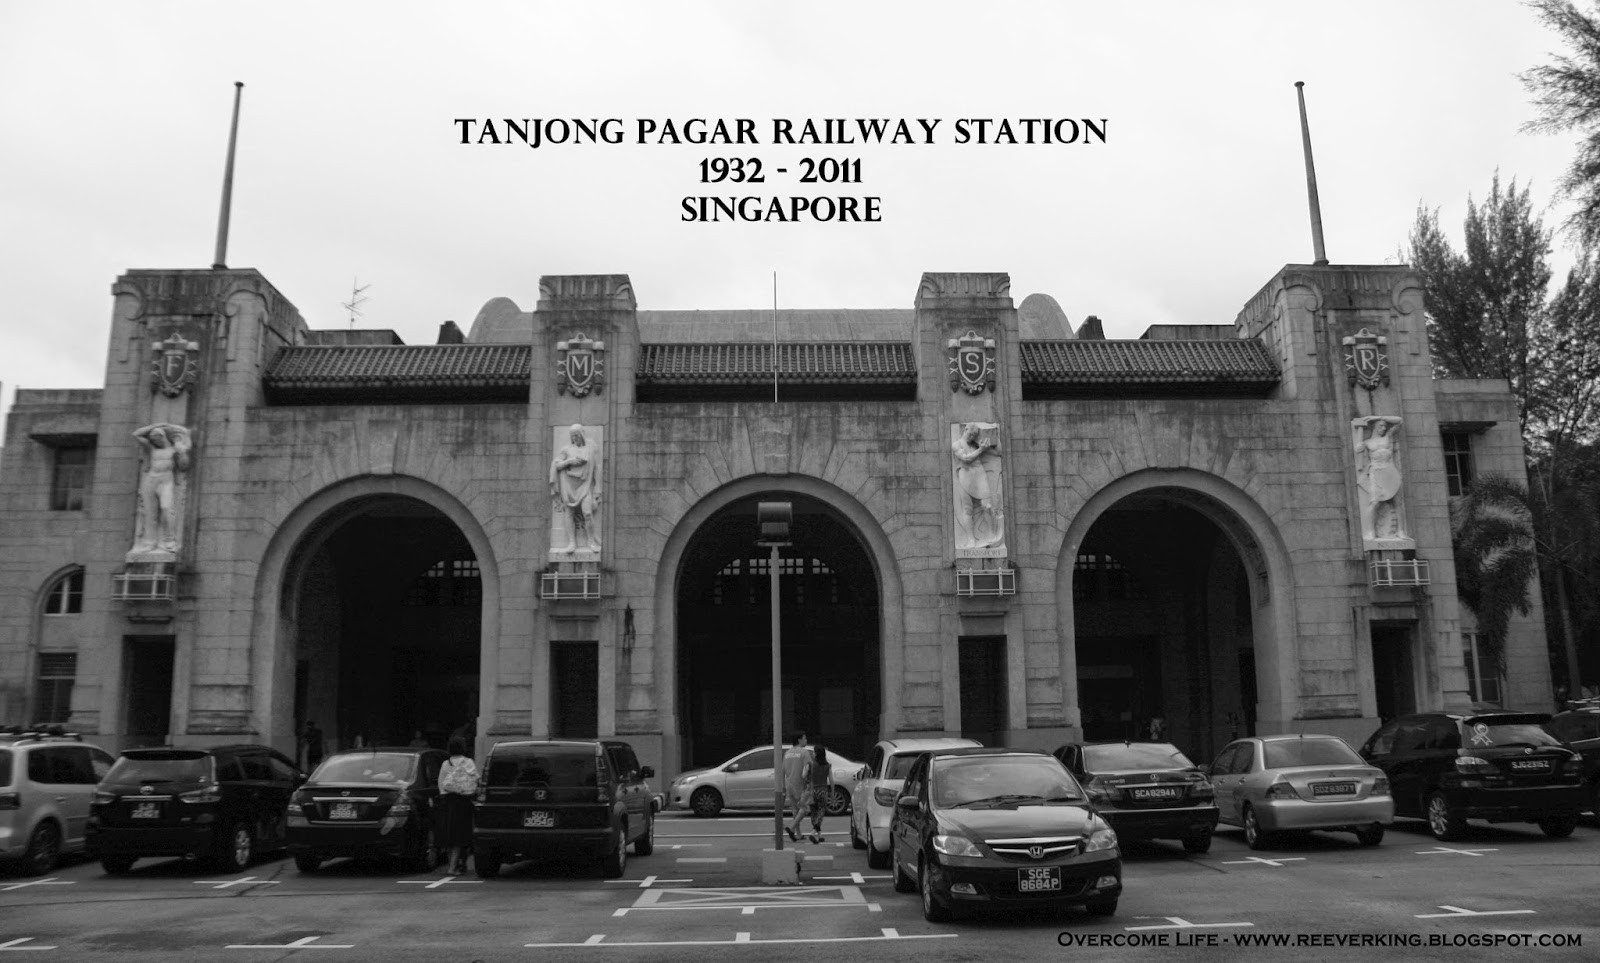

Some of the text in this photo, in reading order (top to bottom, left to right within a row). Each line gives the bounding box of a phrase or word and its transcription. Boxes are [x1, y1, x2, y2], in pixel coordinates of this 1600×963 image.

[166, 355, 182, 377] F
[570, 355, 589, 377] M
[965, 352, 980, 374] S
[1359, 349, 1376, 370] R
[1134, 788, 1177, 798] SCA8294A
[1021, 878, 1059, 890] 8684P
[1028, 868, 1050, 879] SGE
